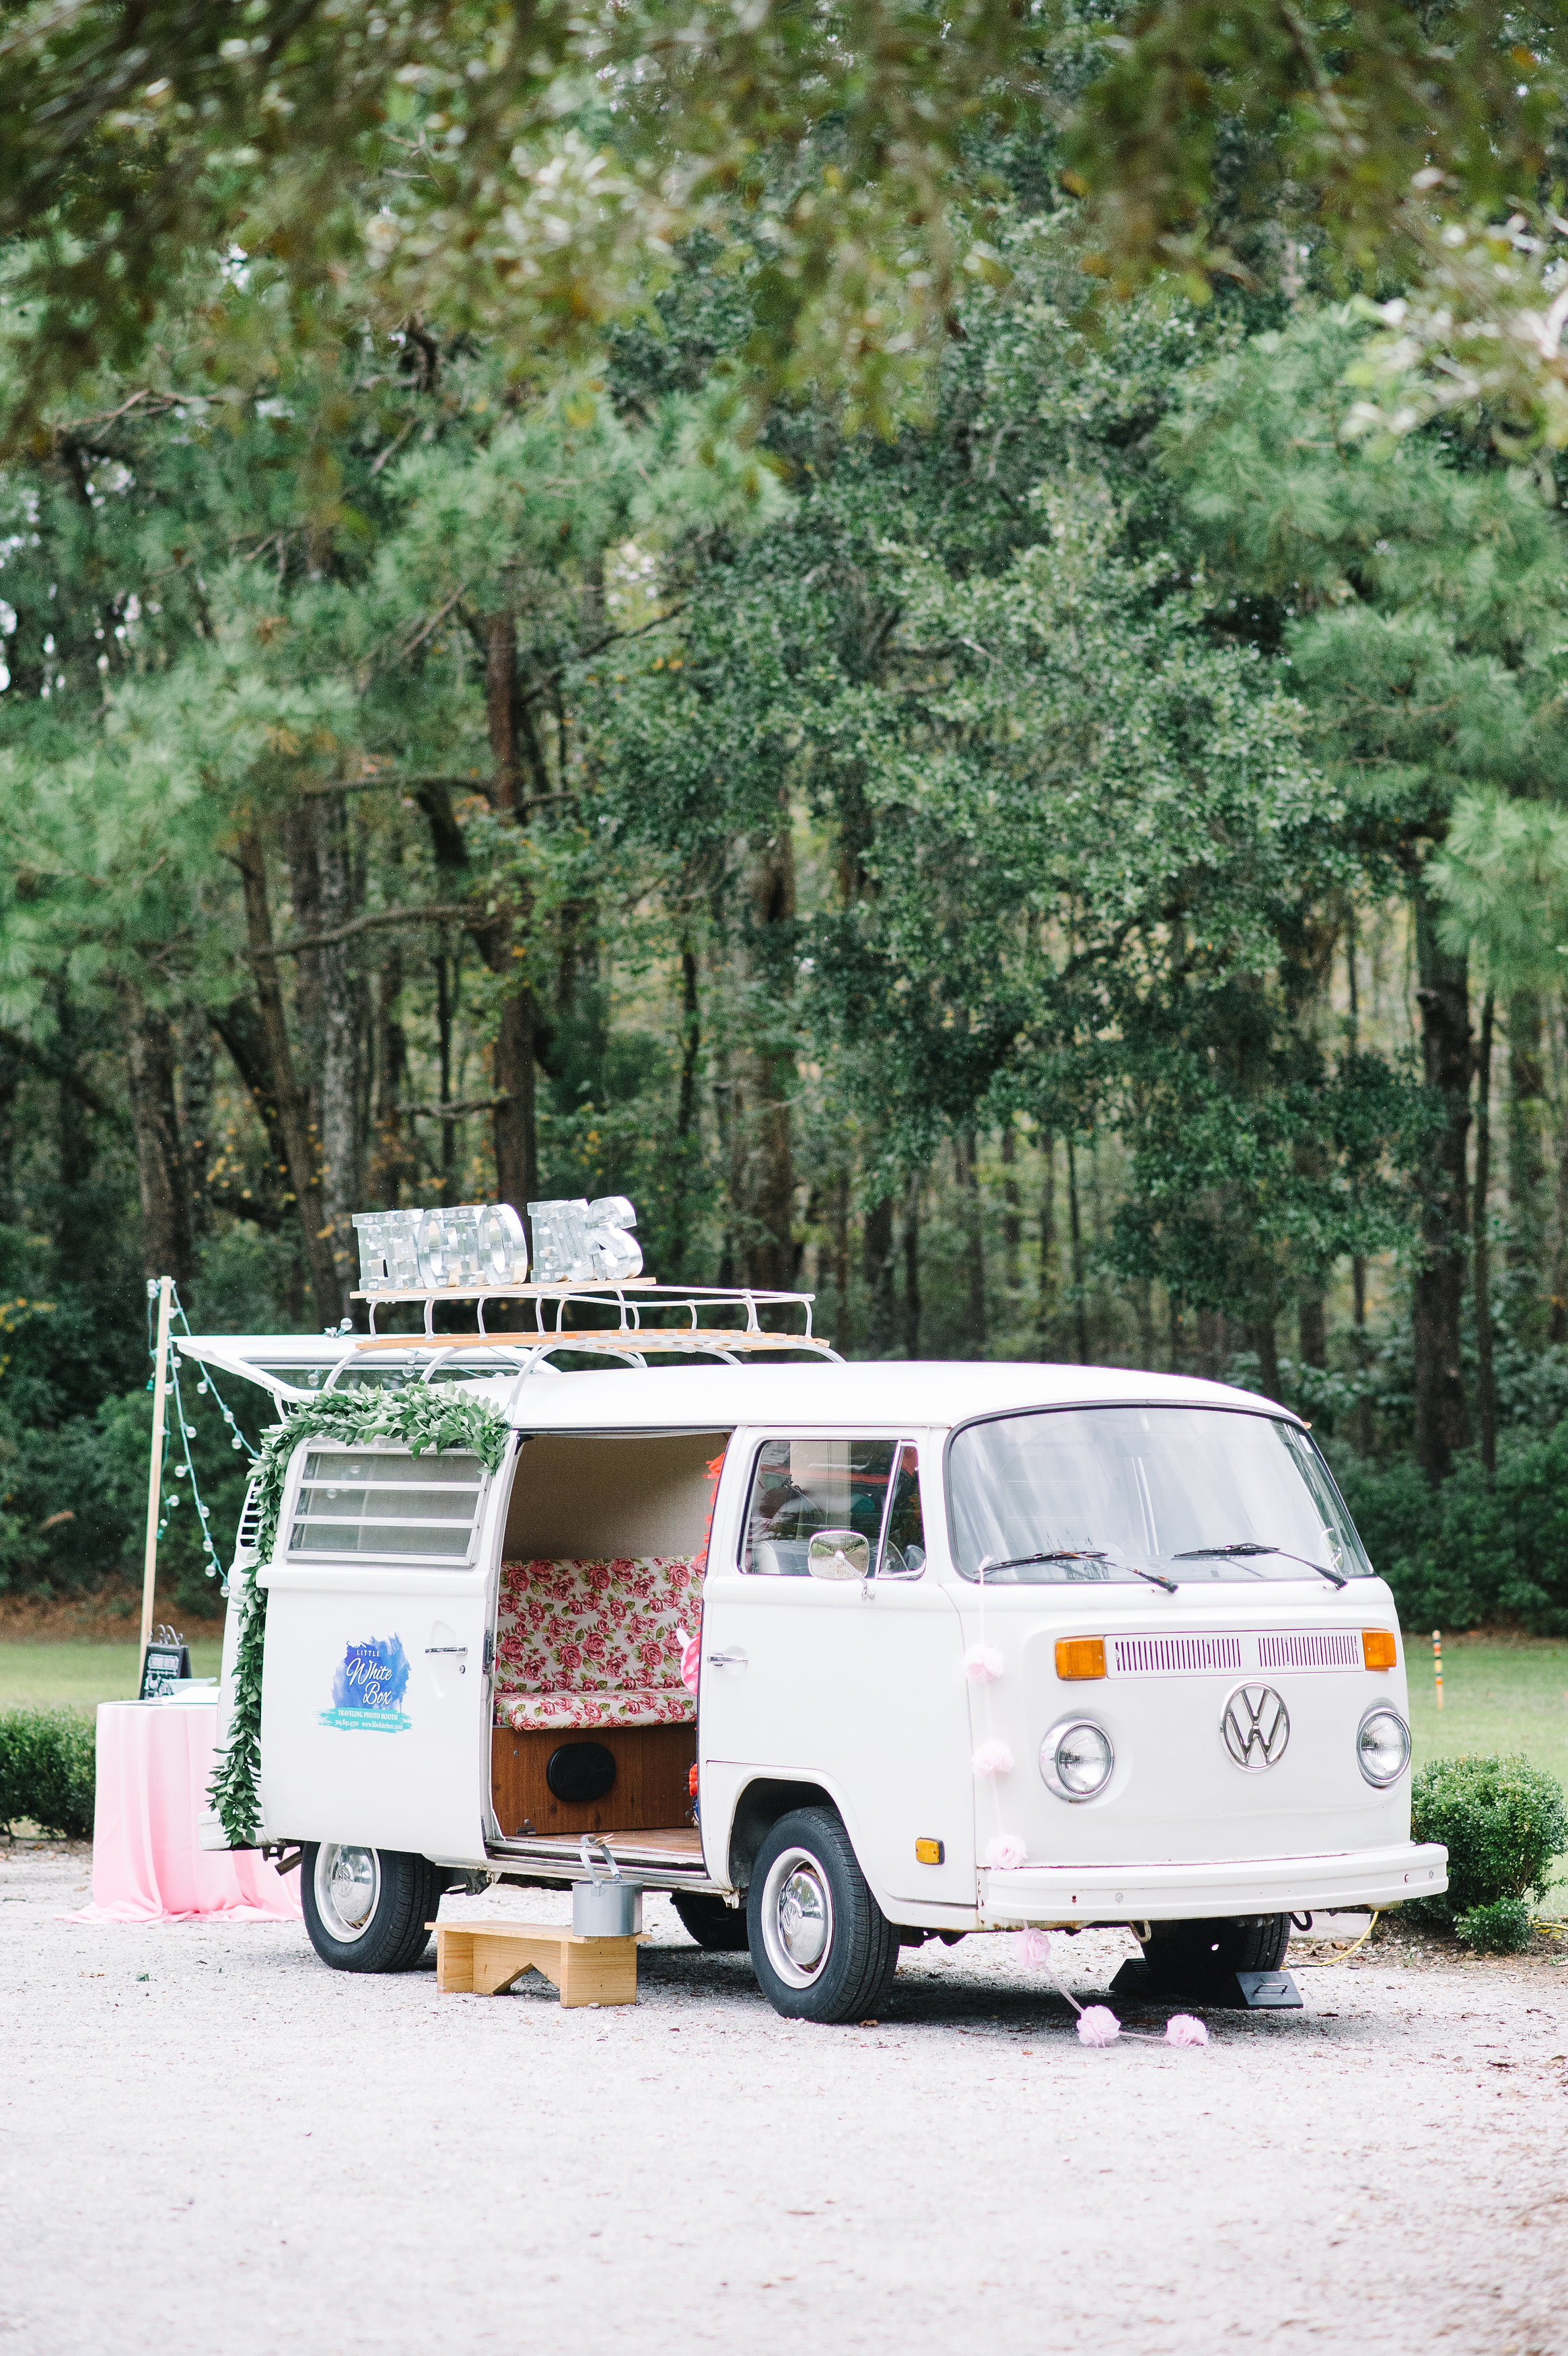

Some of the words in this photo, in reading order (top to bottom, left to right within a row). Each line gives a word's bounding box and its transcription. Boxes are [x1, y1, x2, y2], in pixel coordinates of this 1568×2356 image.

[346, 1658, 392, 1686] White
[363, 1682, 392, 1706] Box
[1224, 1684, 1289, 1768] VW
